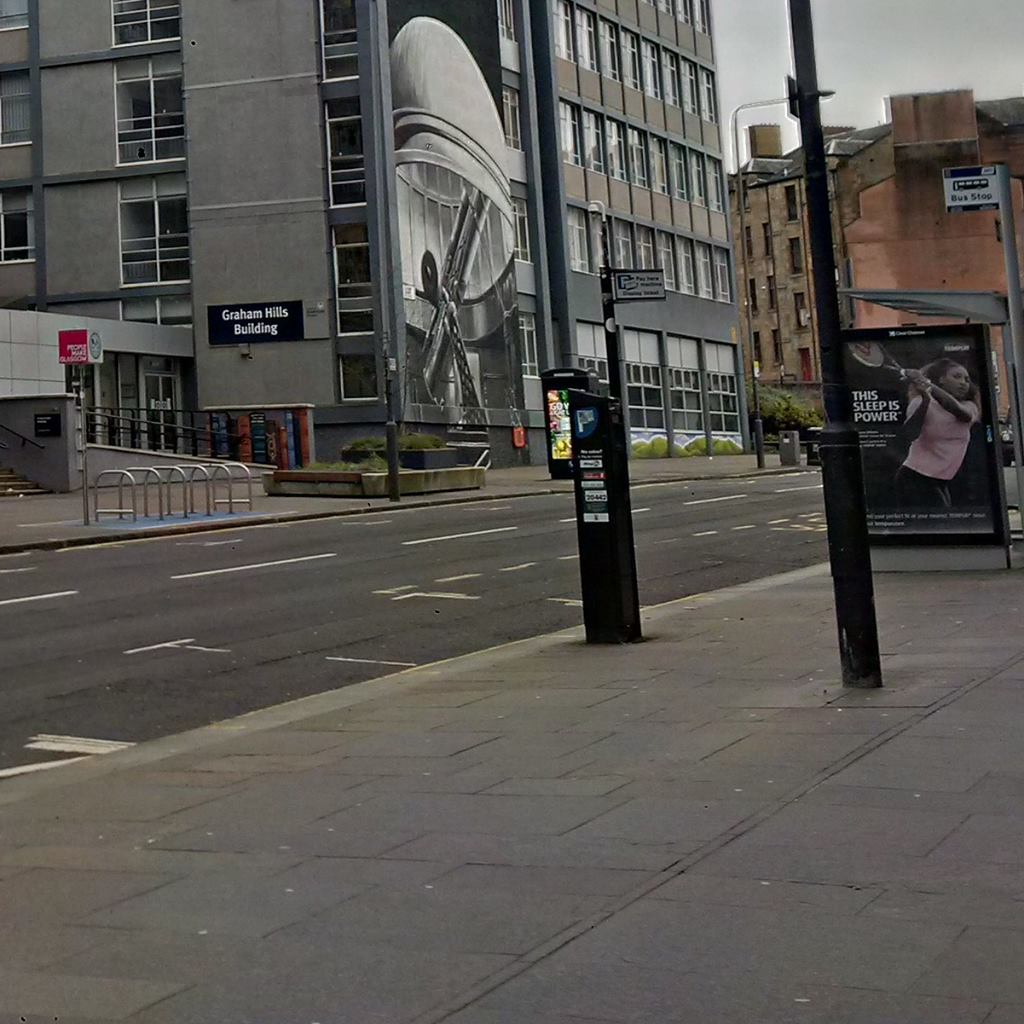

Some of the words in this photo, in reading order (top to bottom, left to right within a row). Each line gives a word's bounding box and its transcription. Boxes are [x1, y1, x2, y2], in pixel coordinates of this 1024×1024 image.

[951, 194, 968, 202] Bus
[971, 193, 993, 201] Stop
[222, 308, 263, 321] Graham
[265, 306, 289, 319] Hills
[234, 323, 278, 335] Building
[851, 390, 879, 402] THIS
[852, 401, 887, 412] SLEEP
[889, 400, 900, 411] IS
